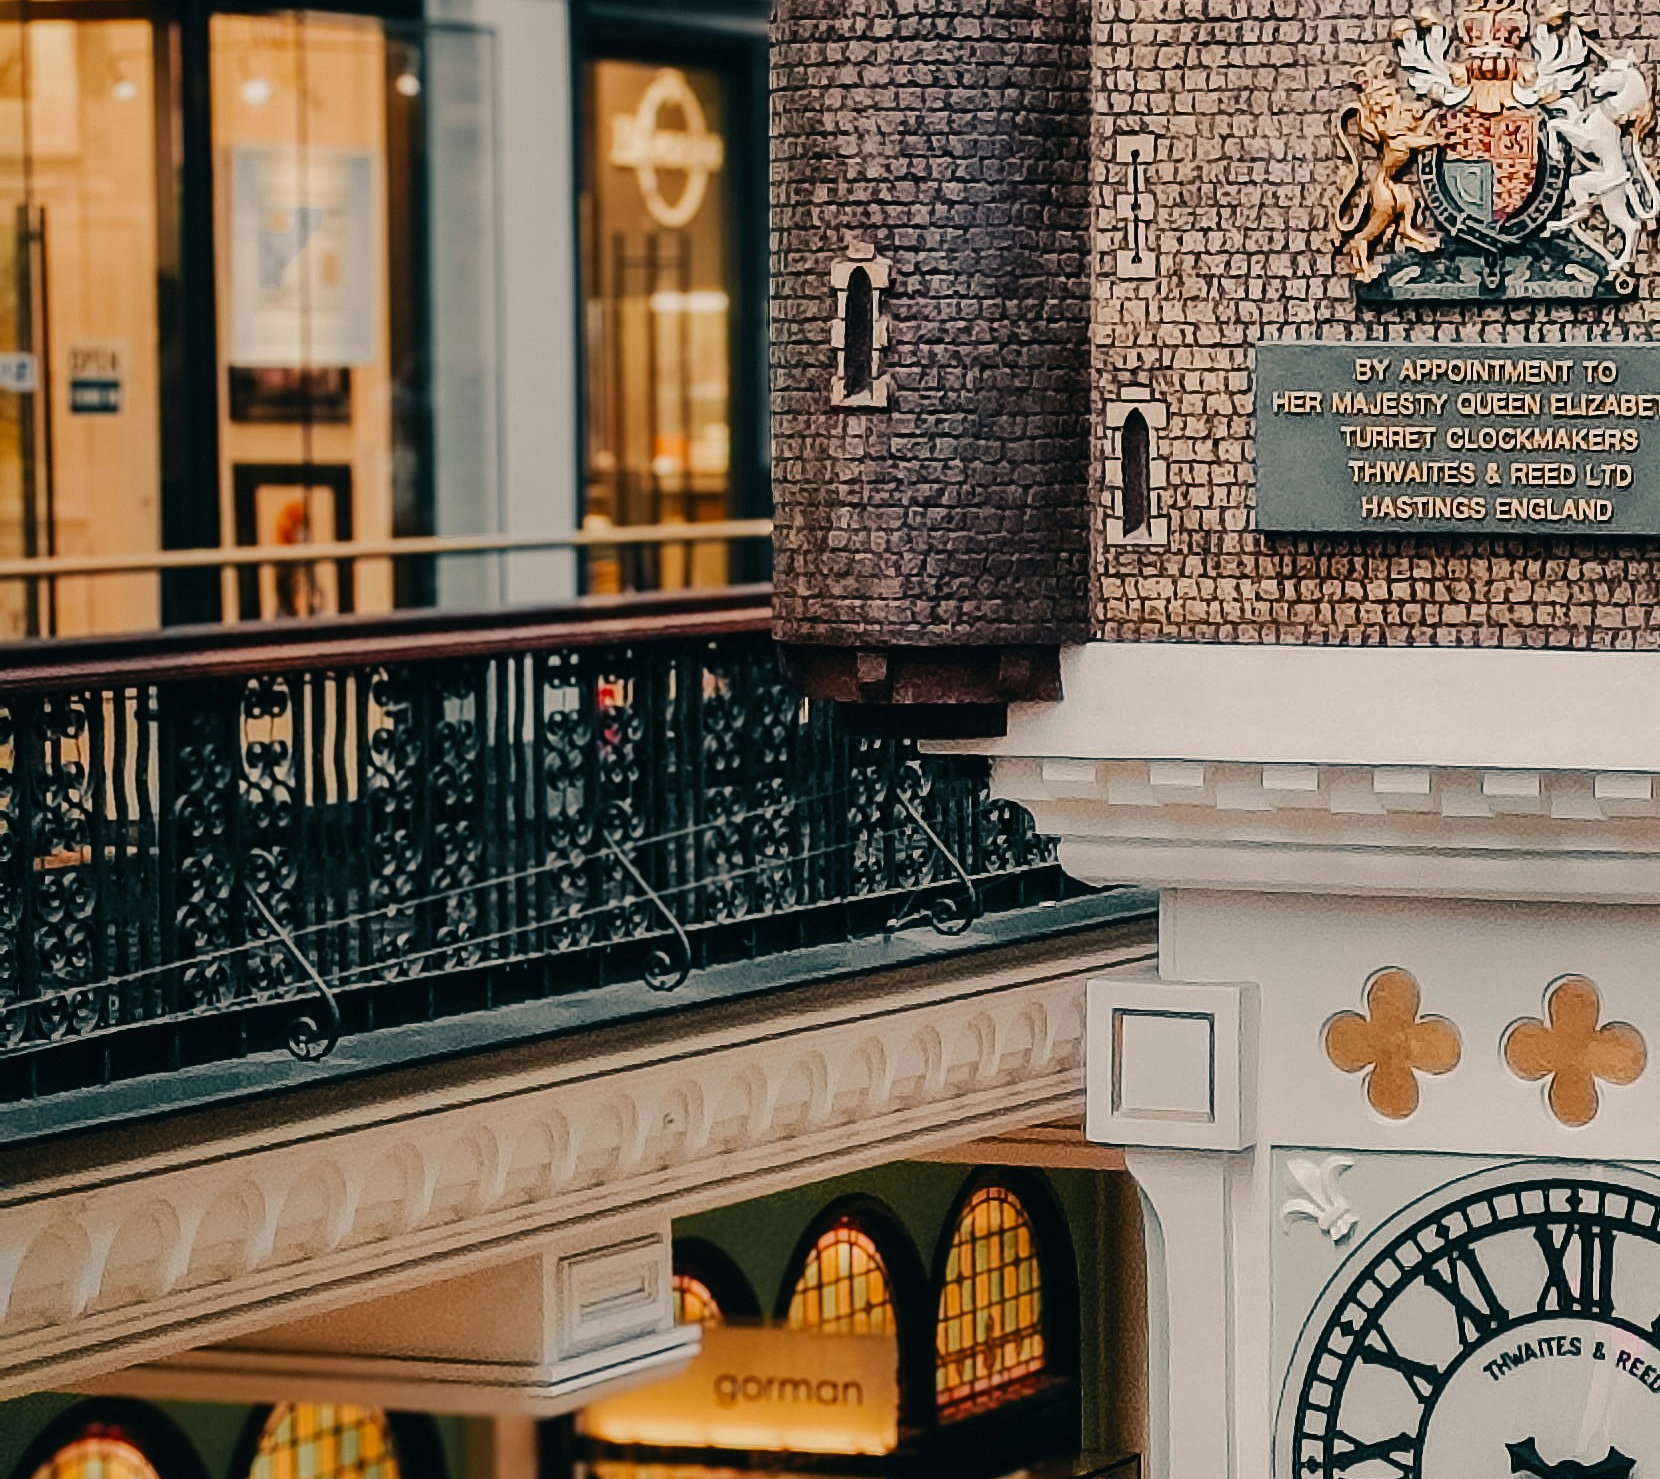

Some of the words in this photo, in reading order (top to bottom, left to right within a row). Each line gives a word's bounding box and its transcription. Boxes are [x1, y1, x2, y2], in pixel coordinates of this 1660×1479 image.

[1354, 358, 1390, 383] BY
[1399, 359, 1573, 384] APPOINTMENT
[1583, 360, 1617, 384] TO
[1272, 391, 1322, 415] HER
[1331, 392, 1448, 416] MAJESTY
[1457, 393, 1541, 417] QUEEN
[1340, 425, 1437, 450] TURRET
[1446, 426, 1639, 451] CLOCKMAKERS
[1347, 460, 1476, 485] THWAITES
[1485, 461, 1501, 485] &
[1509, 462, 1576, 486] REED
[1584, 463, 1632, 487] LTD
[1361, 496, 1486, 520] HASTINGS
[1496, 497, 1614, 522] ENGLAND
[1533, 1222, 1615, 1317] XII
[1424, 1243, 1509, 1345] XI
[1359, 1322, 1441, 1404] X
[1483, 1335, 1582, 1381] THWAITES
[1592, 1341, 1606, 1360] &
[713, 1373, 864, 1409] gorman
